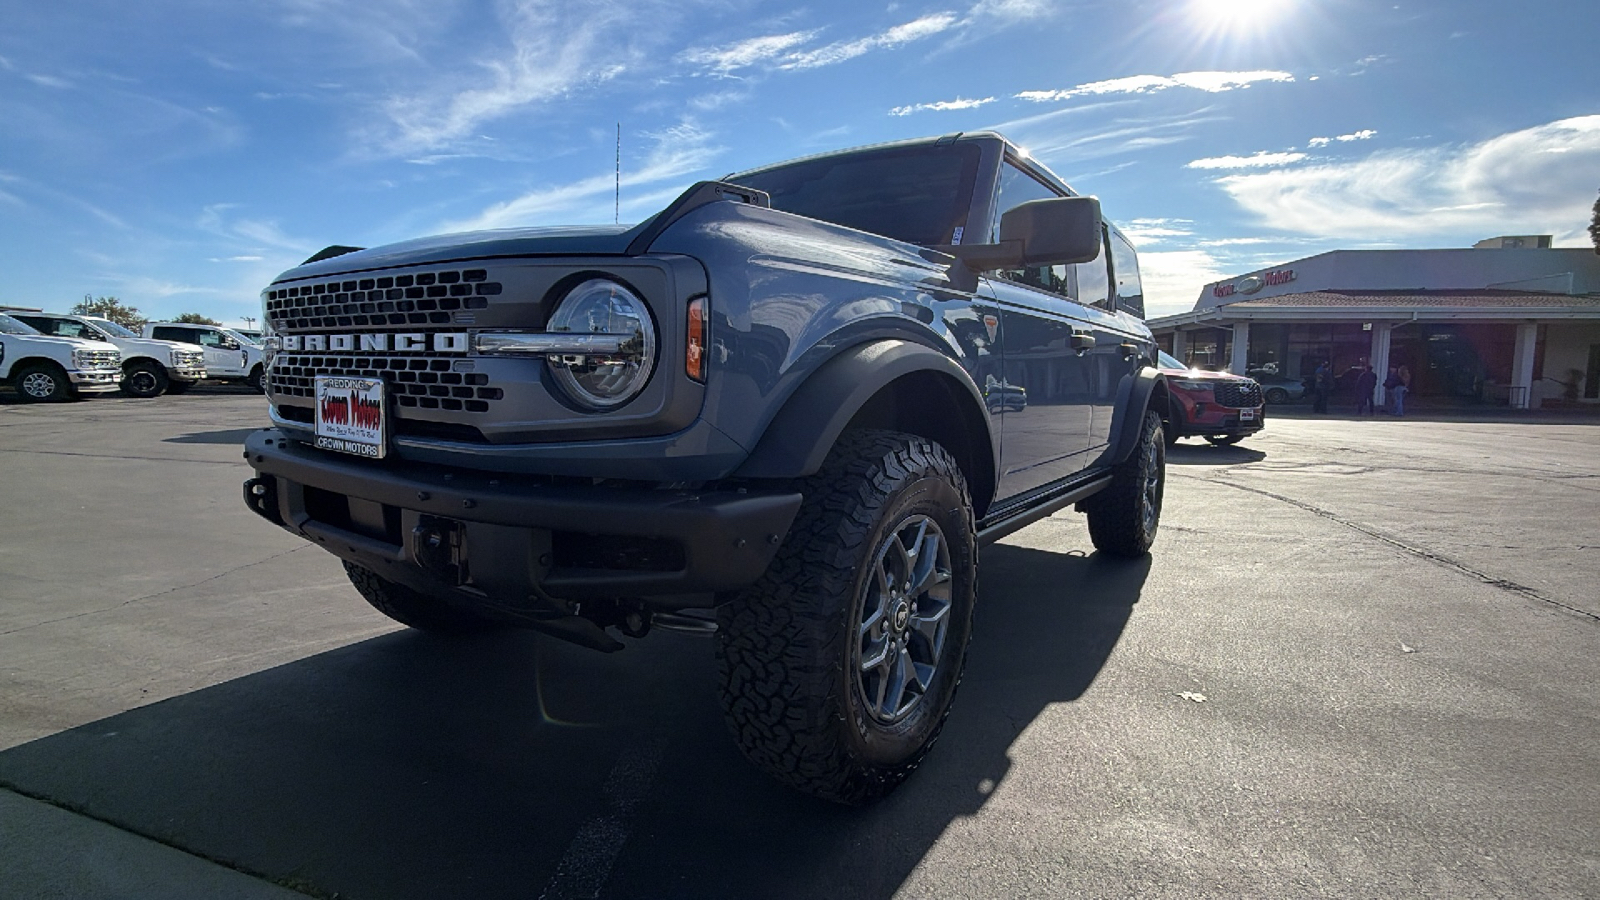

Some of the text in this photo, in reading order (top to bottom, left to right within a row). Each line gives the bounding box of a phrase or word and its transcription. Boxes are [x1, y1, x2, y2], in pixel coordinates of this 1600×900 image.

[282, 332, 468, 352] BRONCO
[328, 379, 364, 389] REDDING
[318, 437, 378, 456] CROWN MOTORS
